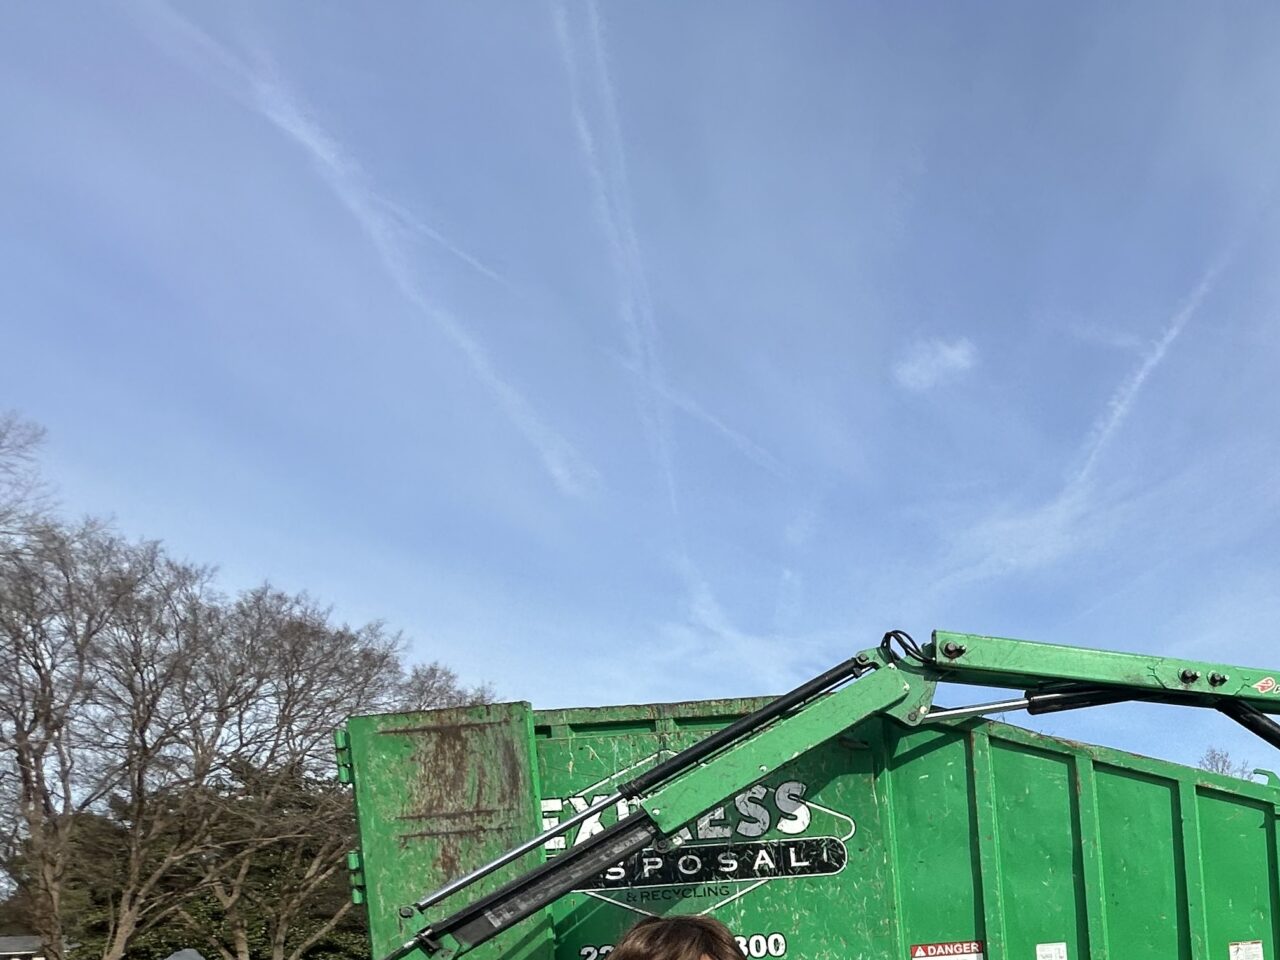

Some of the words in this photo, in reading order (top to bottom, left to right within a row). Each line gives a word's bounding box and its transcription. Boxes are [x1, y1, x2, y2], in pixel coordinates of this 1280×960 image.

[604, 849, 810, 880] SPOSAL
[626, 891, 637, 903] &
[640, 884, 731, 902] RECYCLING
[927, 942, 979, 956] DANGER
